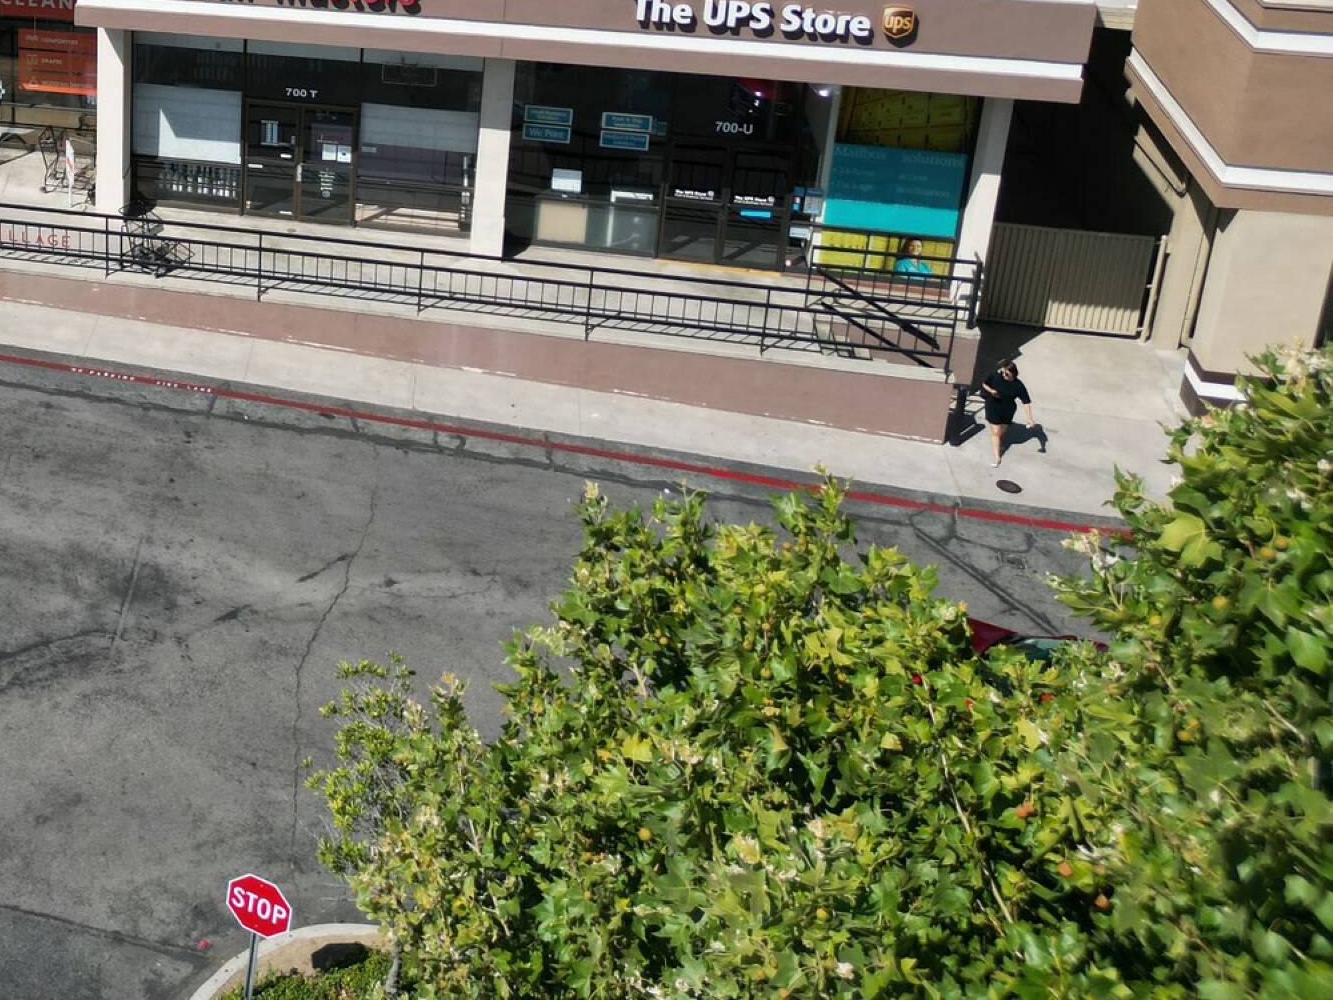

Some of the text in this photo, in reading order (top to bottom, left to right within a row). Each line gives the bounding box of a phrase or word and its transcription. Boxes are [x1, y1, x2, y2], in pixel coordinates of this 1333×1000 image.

[780, 4, 871, 37] Store
[884, 15, 913, 34] ups
[285, 87, 318, 98] 700 T
[716, 121, 753, 135] 700-U
[232, 887, 287, 924] STOP
